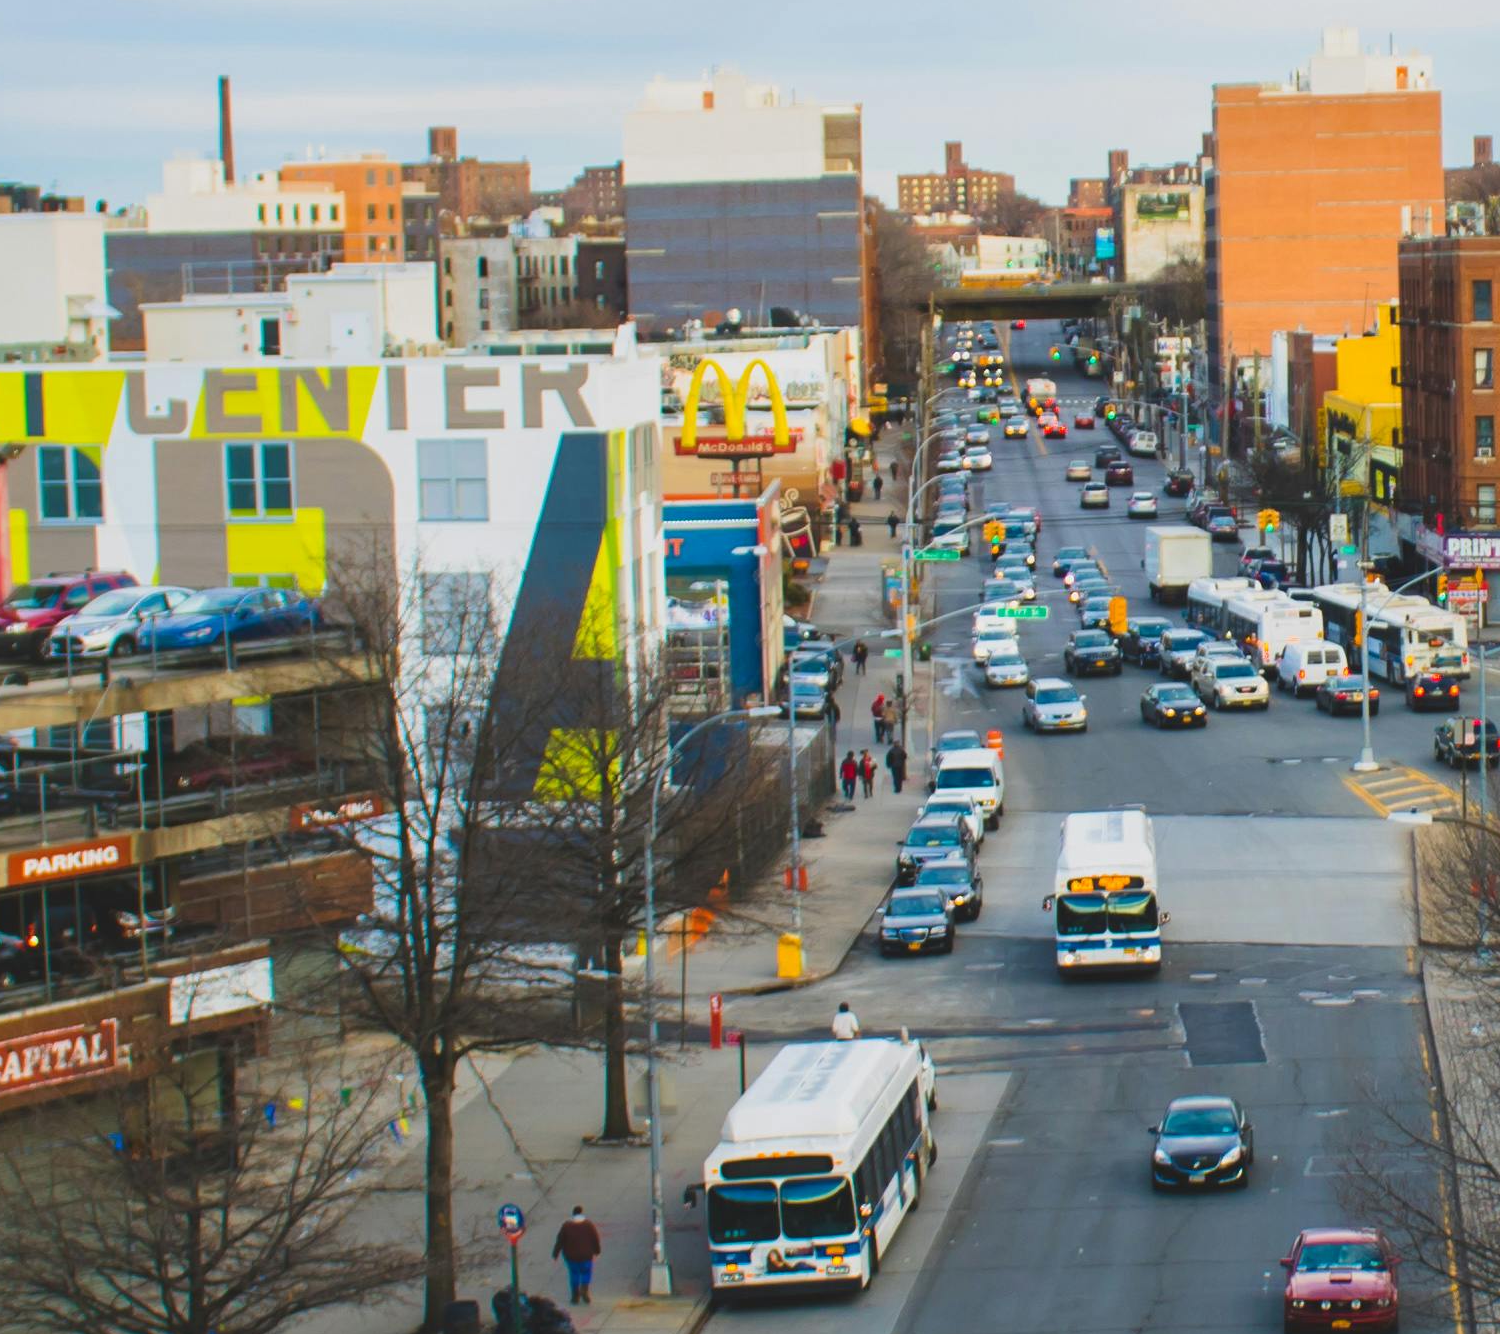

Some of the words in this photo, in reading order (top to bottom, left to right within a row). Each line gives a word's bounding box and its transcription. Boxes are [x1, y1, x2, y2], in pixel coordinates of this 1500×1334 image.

[698, 442, 773, 453] McDonald's
[1448, 537, 1500, 557] PRINT
[22, 845, 118, 878] PARKING
